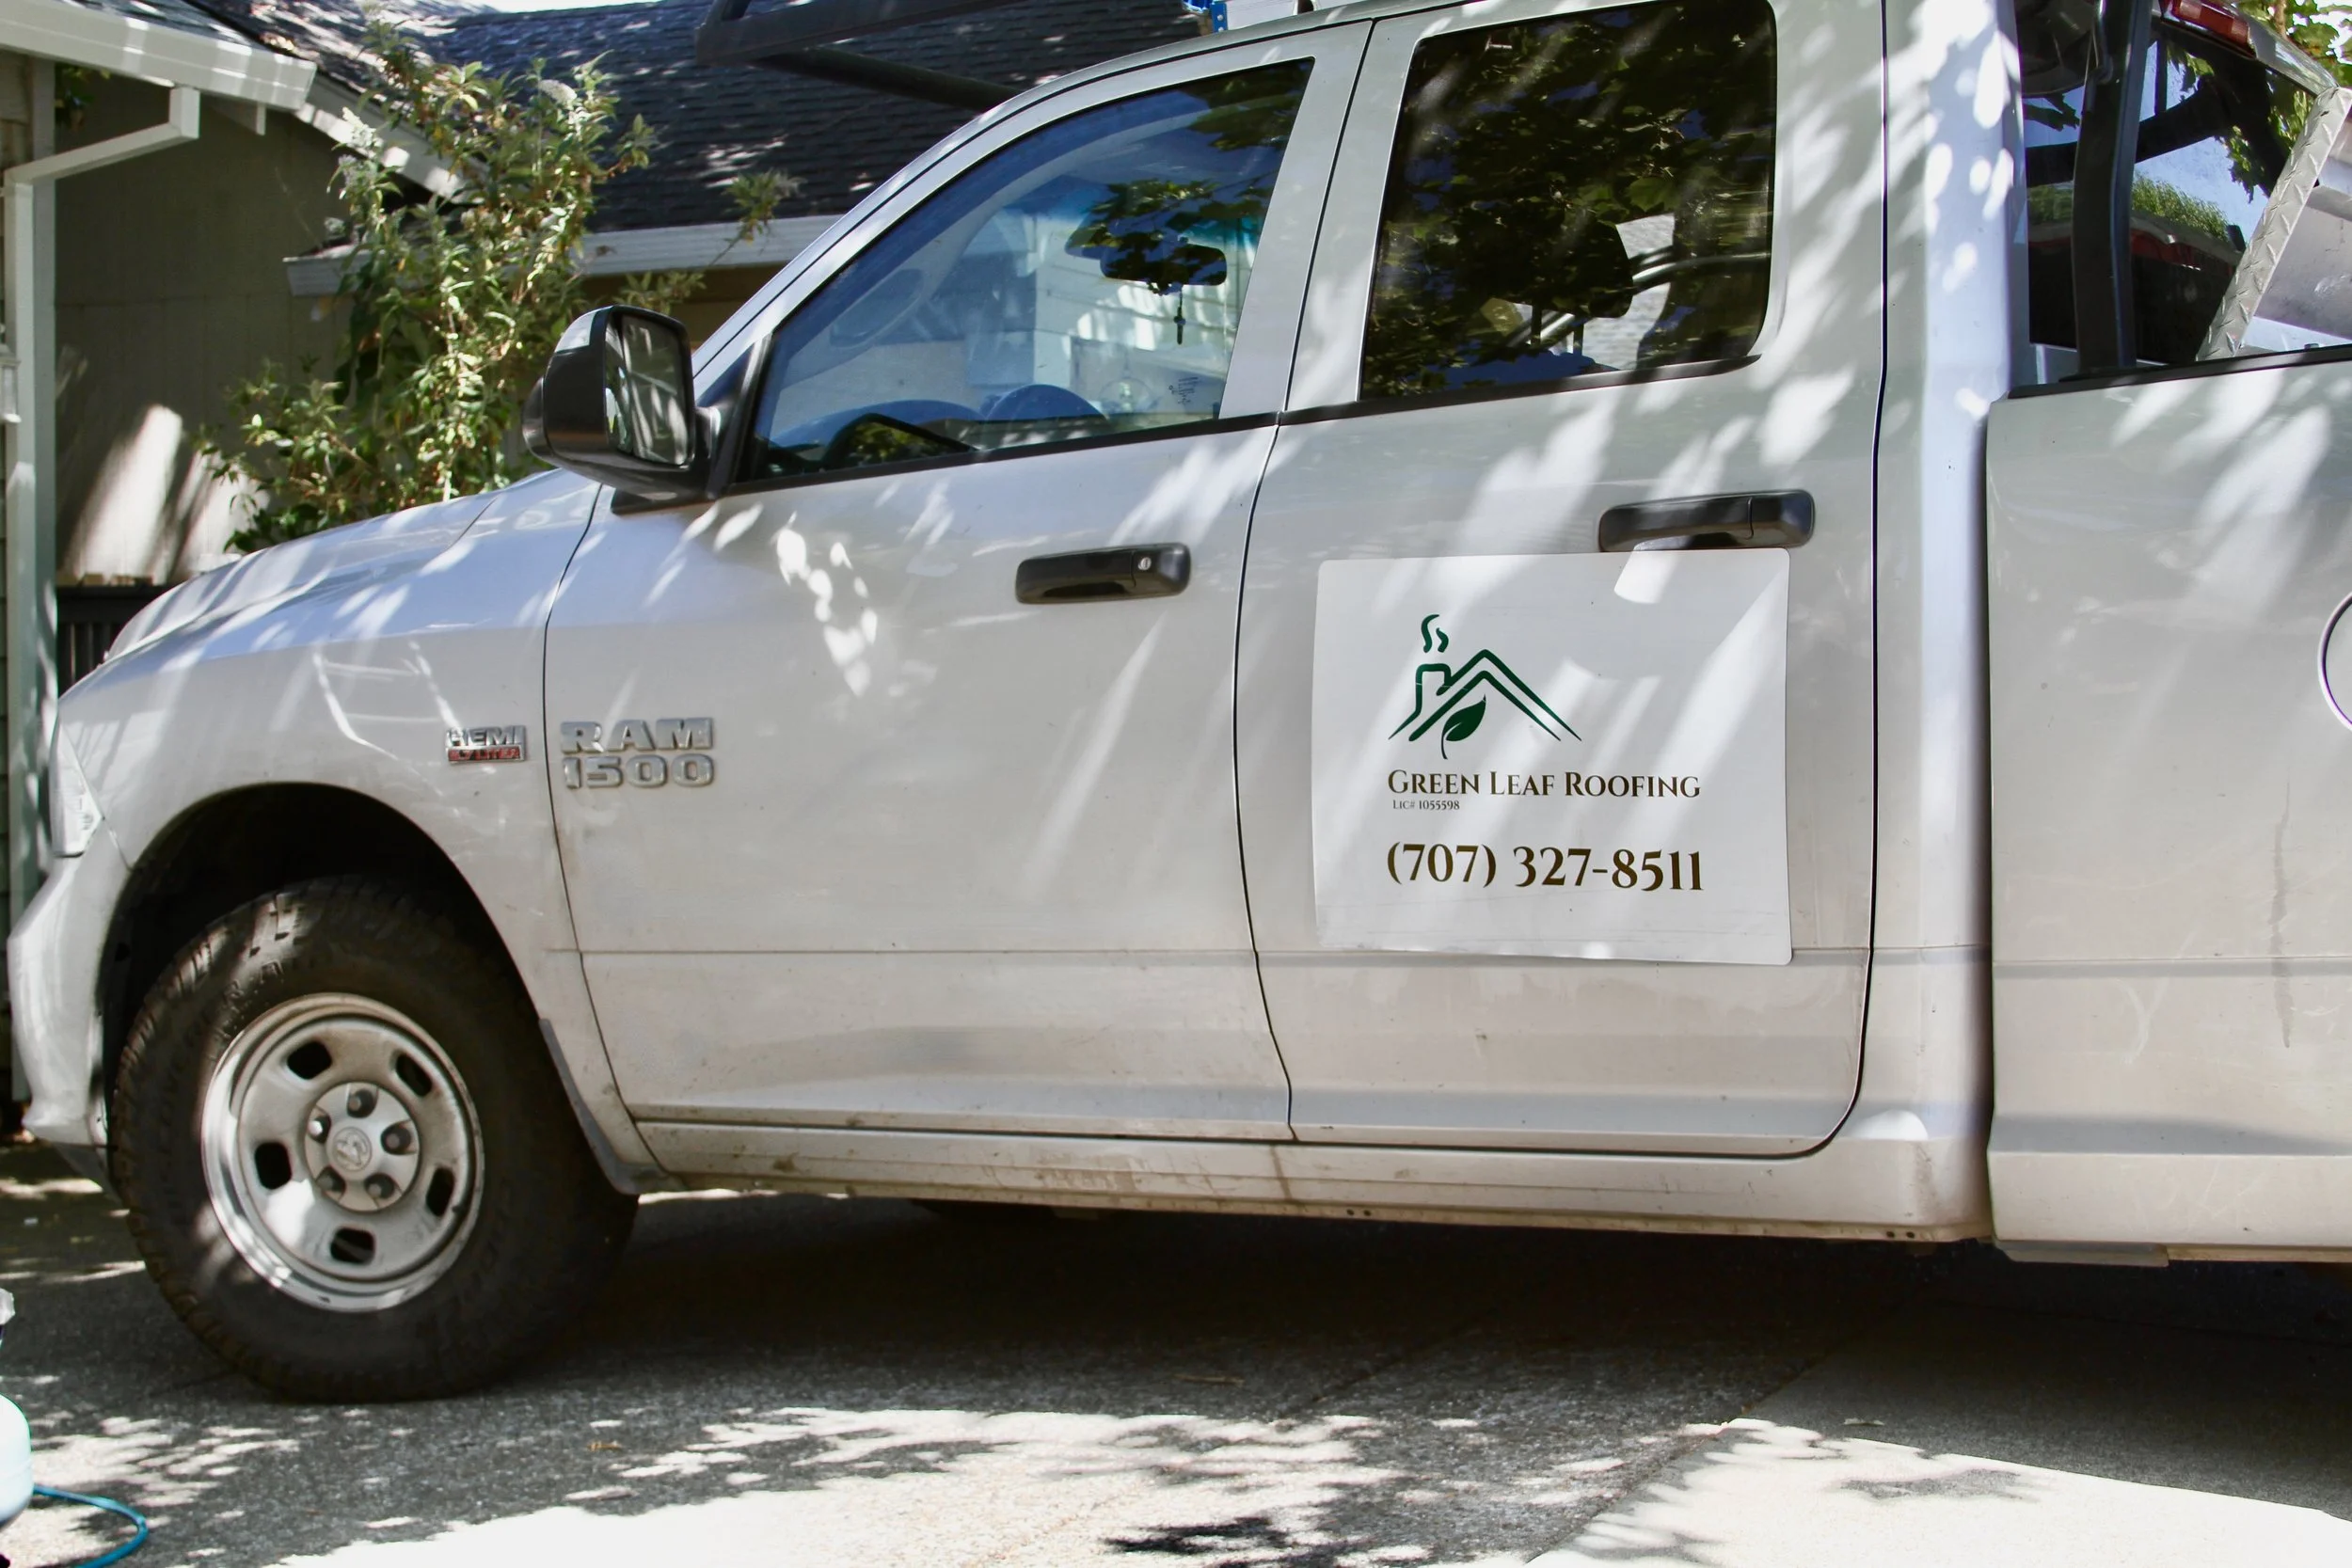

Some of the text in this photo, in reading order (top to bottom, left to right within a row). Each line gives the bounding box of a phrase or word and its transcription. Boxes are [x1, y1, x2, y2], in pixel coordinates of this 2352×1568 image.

[446, 725, 526, 746] HEMI
[561, 717, 714, 753] RAM
[563, 752, 715, 789] 1500
[1387, 769, 1701, 798] GREEN LEAF ROOFING
[1419, 800, 1460, 810] 1055598
[1387, 841, 1704, 891] (707) 327-8511
